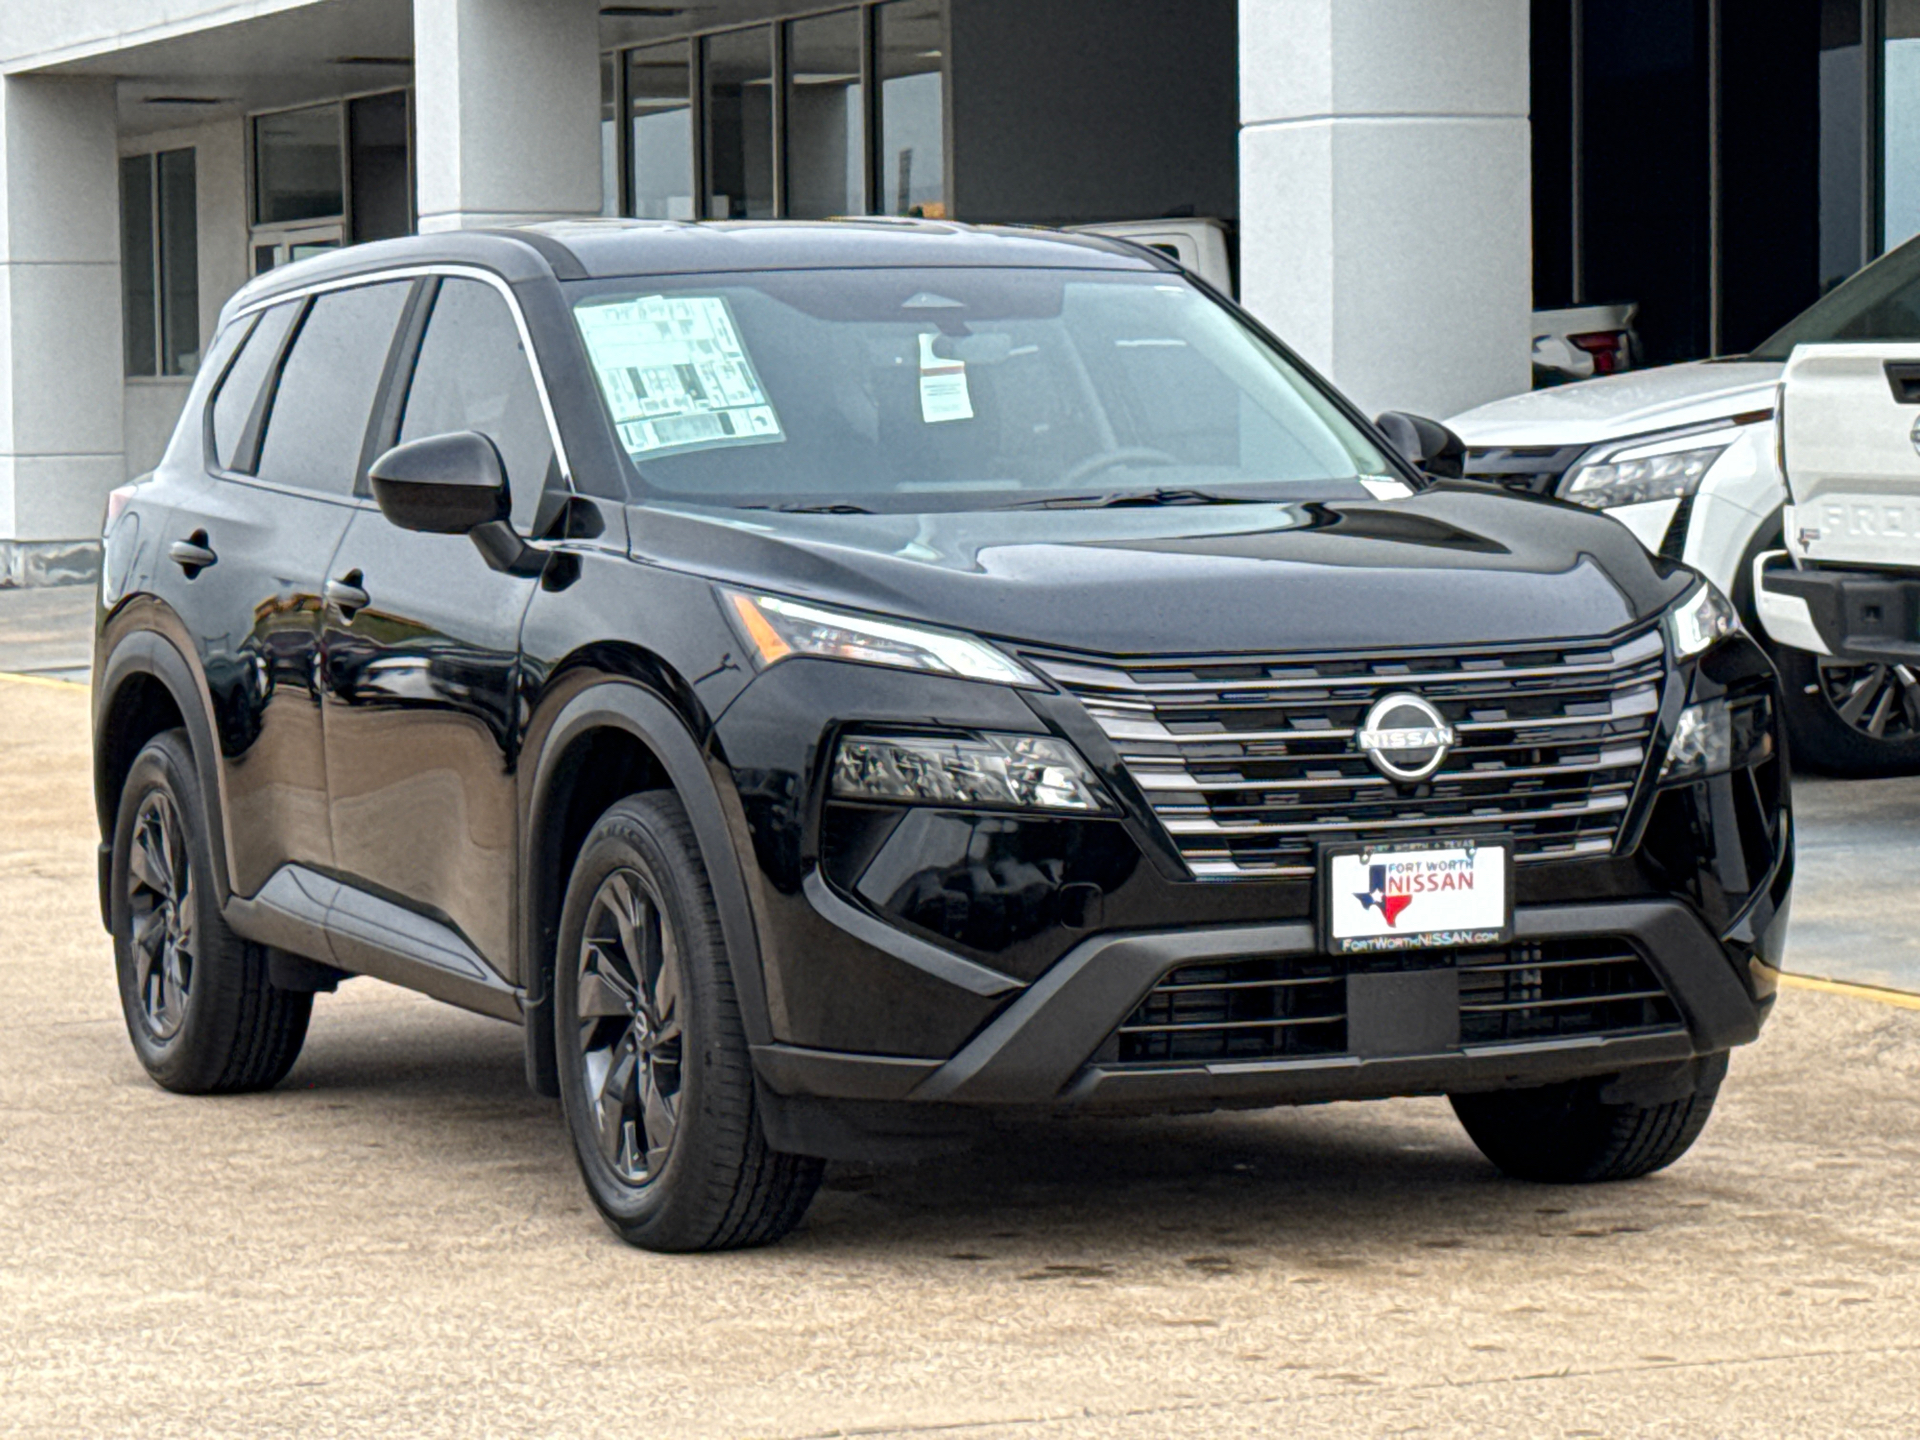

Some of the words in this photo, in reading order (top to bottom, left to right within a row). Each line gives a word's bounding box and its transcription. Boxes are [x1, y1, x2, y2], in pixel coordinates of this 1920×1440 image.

[1821, 503, 1920, 537] FRO
[1360, 730, 1453, 749] NISSAN
[1388, 861, 1422, 874] FORT
[1426, 859, 1474, 872] WORTH
[1388, 871, 1474, 893] NISSAN
